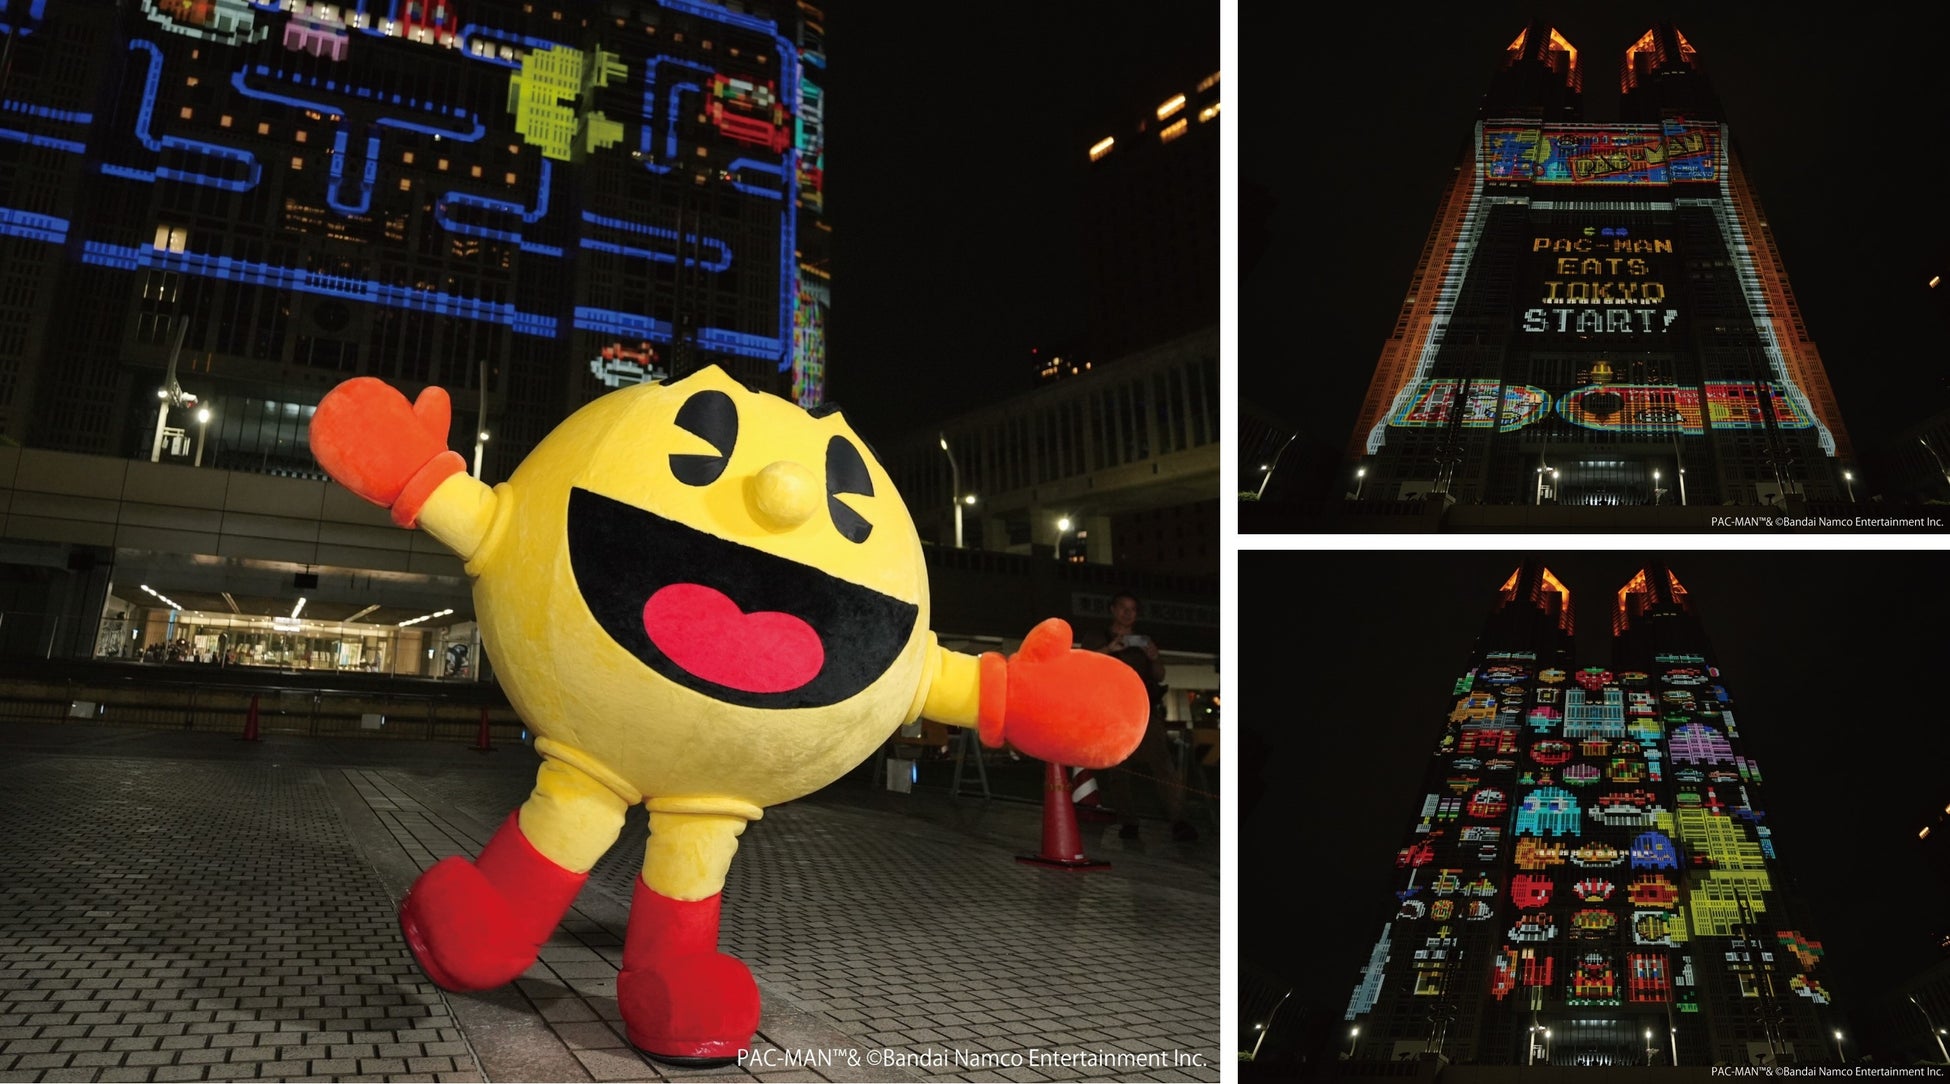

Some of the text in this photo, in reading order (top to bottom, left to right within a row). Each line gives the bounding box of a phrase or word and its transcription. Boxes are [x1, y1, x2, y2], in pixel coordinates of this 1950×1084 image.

[1574, 133, 1704, 178] PAC-MAN
[1533, 237, 1673, 253] PAC-MAN
[1557, 257, 1649, 275] EATS
[1544, 281, 1665, 303] TOKYO
[1522, 308, 1678, 333] START!
